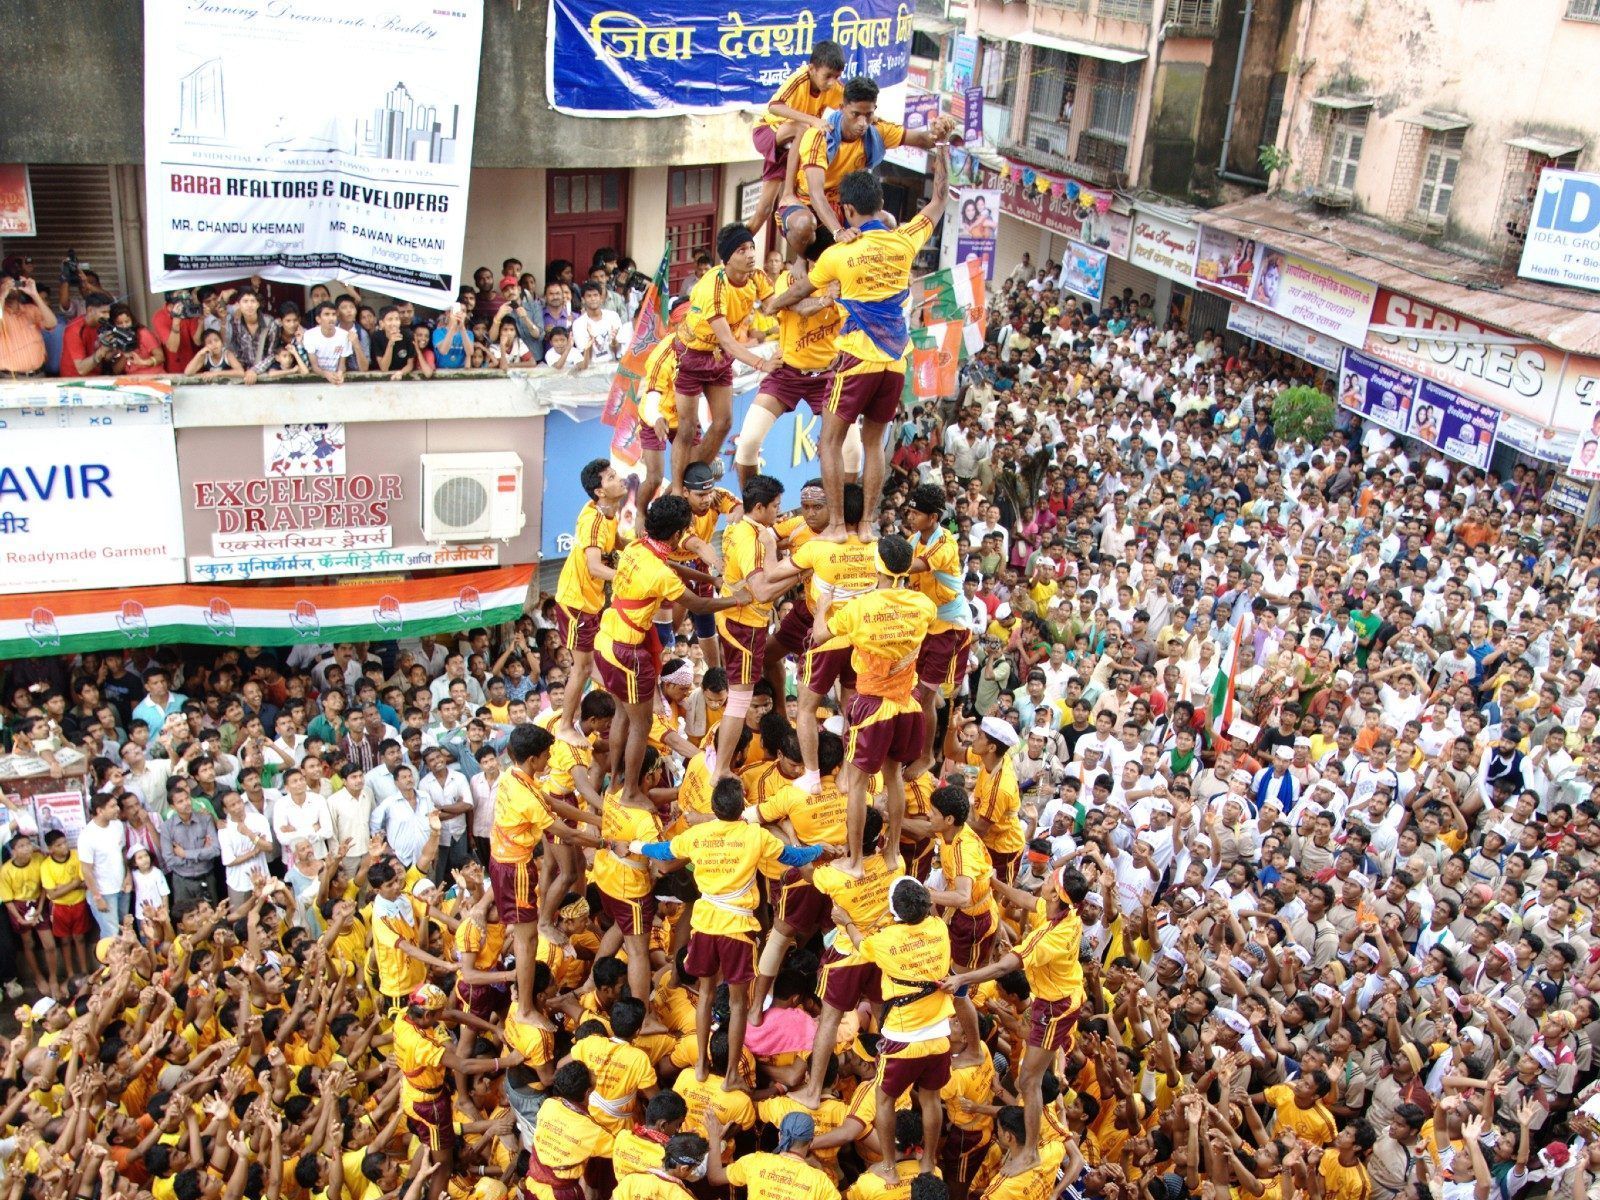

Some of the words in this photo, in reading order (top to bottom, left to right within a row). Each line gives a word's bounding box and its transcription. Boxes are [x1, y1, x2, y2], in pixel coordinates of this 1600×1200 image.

[587, 11, 696, 61] जिवा
[718, 9, 817, 59] देवशी
[831, 6, 892, 50] निवास
[227, 178, 318, 199] REALTORS
[323, 180, 335, 197] &
[340, 181, 449, 213] DEVELOPERS
[171, 218, 194, 232] MR.
[197, 220, 247, 234] CHANDU
[252, 222, 305, 234] KHEMANI
[329, 221, 349, 233] MR.
[352, 225, 393, 245] PAWAN
[396, 233, 445, 250] KHEMANI
[1046, 218, 1081, 238] BHANDA
[1533, 231, 1569, 247] IDEAL
[1563, 254, 1572, 263] IT
[1531, 263, 1559, 276] Health
[1562, 269, 1599, 284] Tourism
[1381, 295, 1546, 397] STORES
[1372, 342, 1416, 369] GAMES
[1427, 365, 1465, 389] TOYS
[0, 464, 113, 502] AVIR
[193, 473, 404, 511] EXCELSIOR
[215, 500, 389, 535] DRAPERS
[218, 533, 338, 553] एक्सेलसियर
[342, 529, 388, 549] ड्रेपर्स
[6, 548, 97, 565] Readymade
[102, 544, 168, 560] Garment
[406, 552, 432, 567] आणि
[434, 544, 496, 565] होजीयरी
